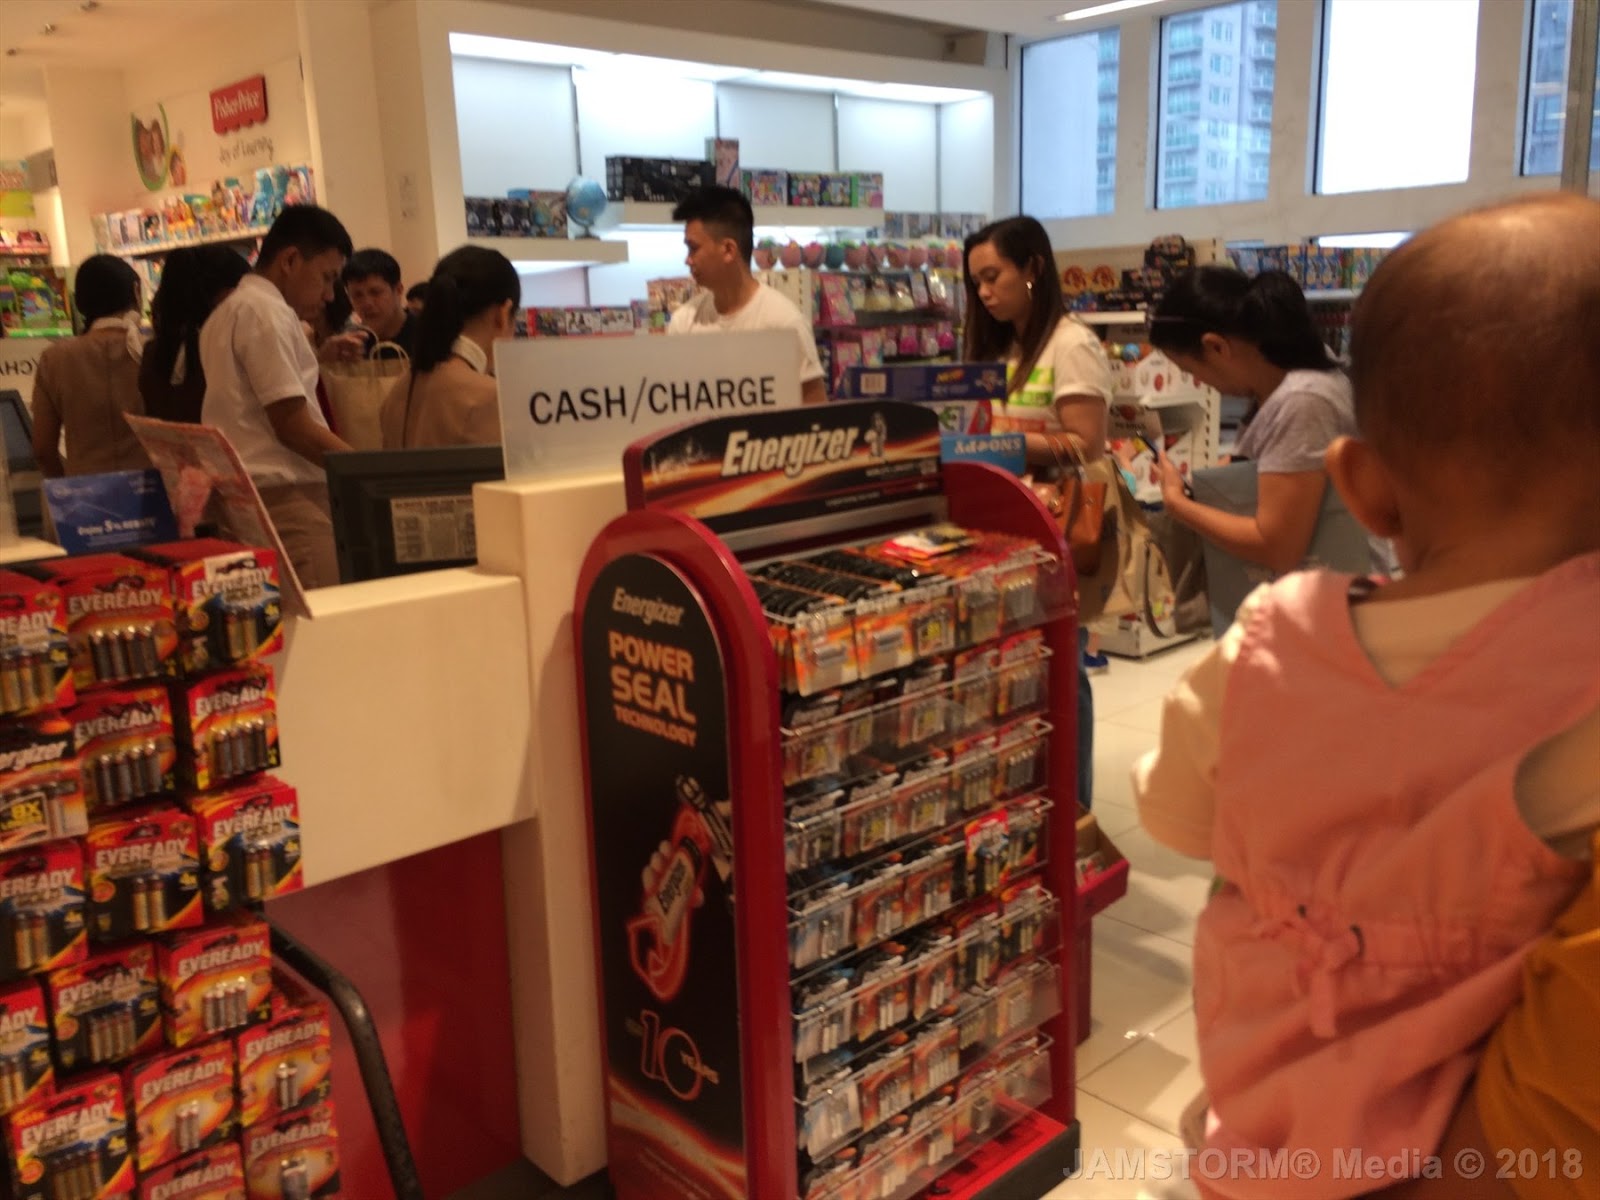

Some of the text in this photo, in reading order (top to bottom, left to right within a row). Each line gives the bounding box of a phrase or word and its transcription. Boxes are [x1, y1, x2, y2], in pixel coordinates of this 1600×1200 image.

[528, 375, 777, 424] CASH/CHARGE
[721, 424, 860, 477] Energizer
[68, 588, 164, 614] EVEREADY
[612, 586, 684, 626] Energizer
[608, 631, 695, 683] POWER
[611, 664, 696, 724] SEAL
[74, 704, 164, 745] EVEREADY
[613, 703, 697, 747] TECHNOLOGY
[213, 803, 293, 840] EVEREADY
[95, 838, 189, 869] EVEREADY
[178, 940, 265, 977] EVEREADY
[246, 1018, 323, 1059] EVEREADY
[142, 1056, 225, 1100] EVEREADY
[21, 1099, 115, 1150] EVEREADY
[252, 1118, 331, 1157] EVEREADY
